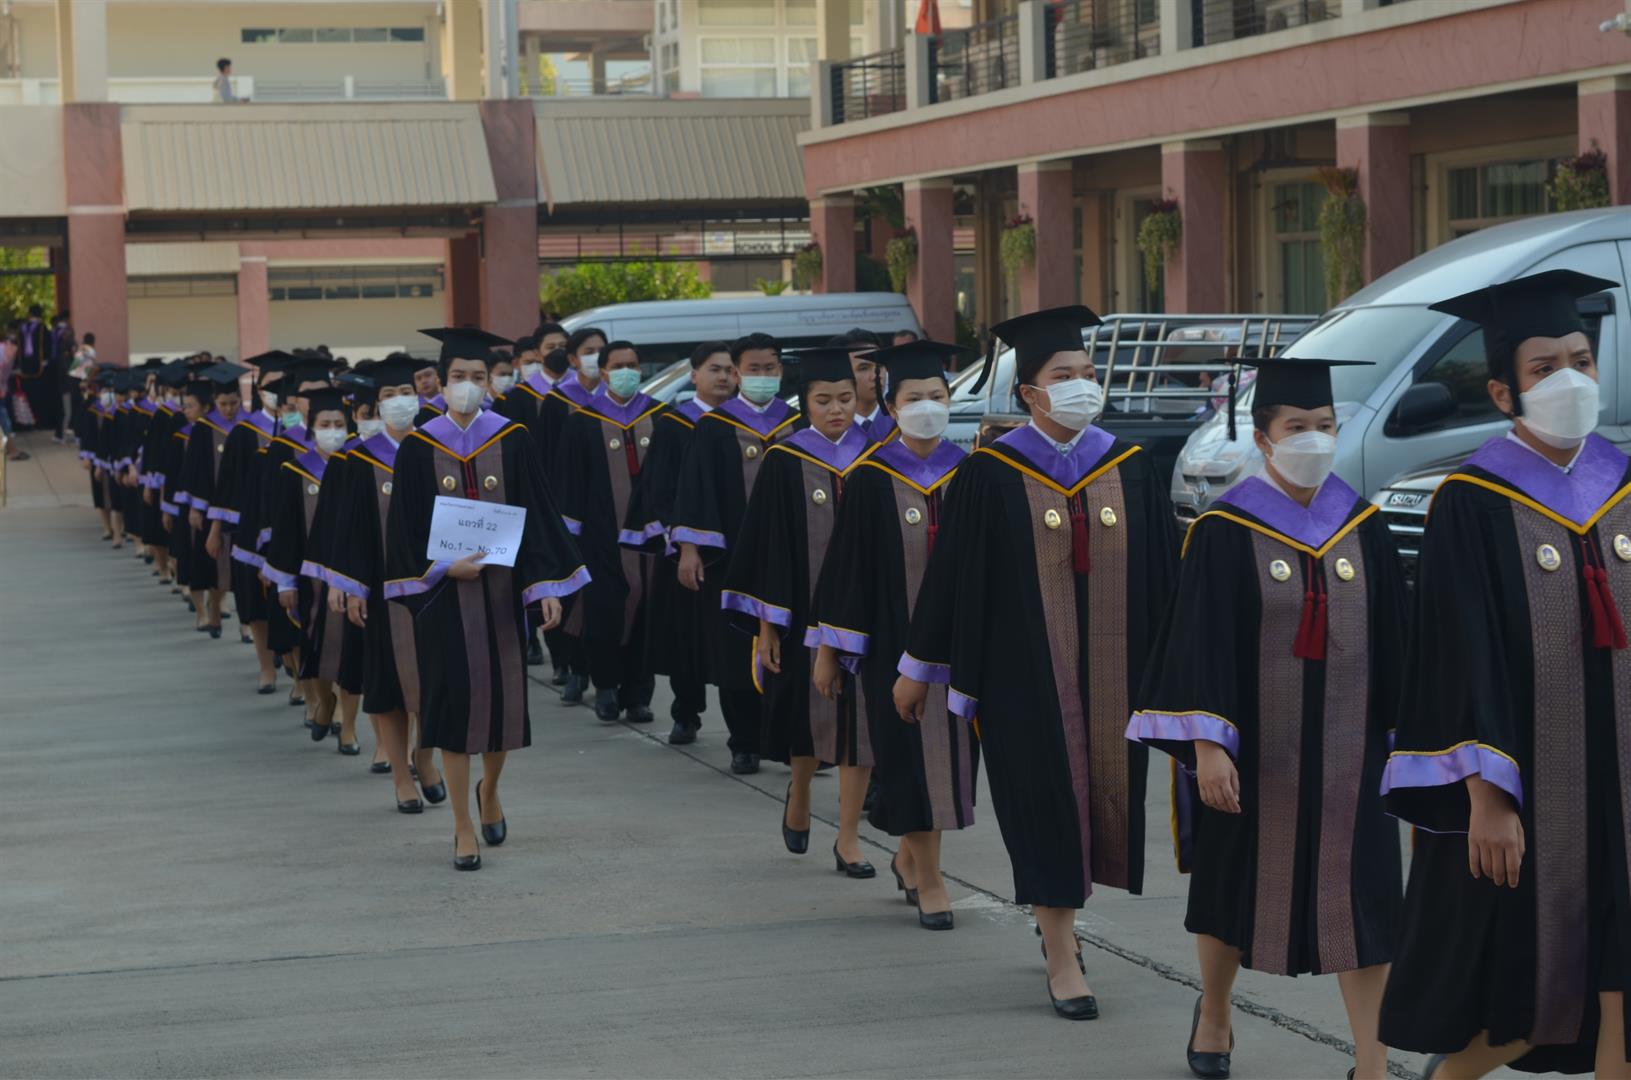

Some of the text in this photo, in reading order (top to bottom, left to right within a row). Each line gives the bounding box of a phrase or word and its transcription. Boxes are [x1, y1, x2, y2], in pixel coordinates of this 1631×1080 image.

[735, 243, 772, 254] SCHOOL
[1390, 493, 1424, 505] ISUZU
[458, 517, 498, 531] แถวที่ 22
[440, 539, 463, 551] No.1
[477, 545, 508, 555] No.70
